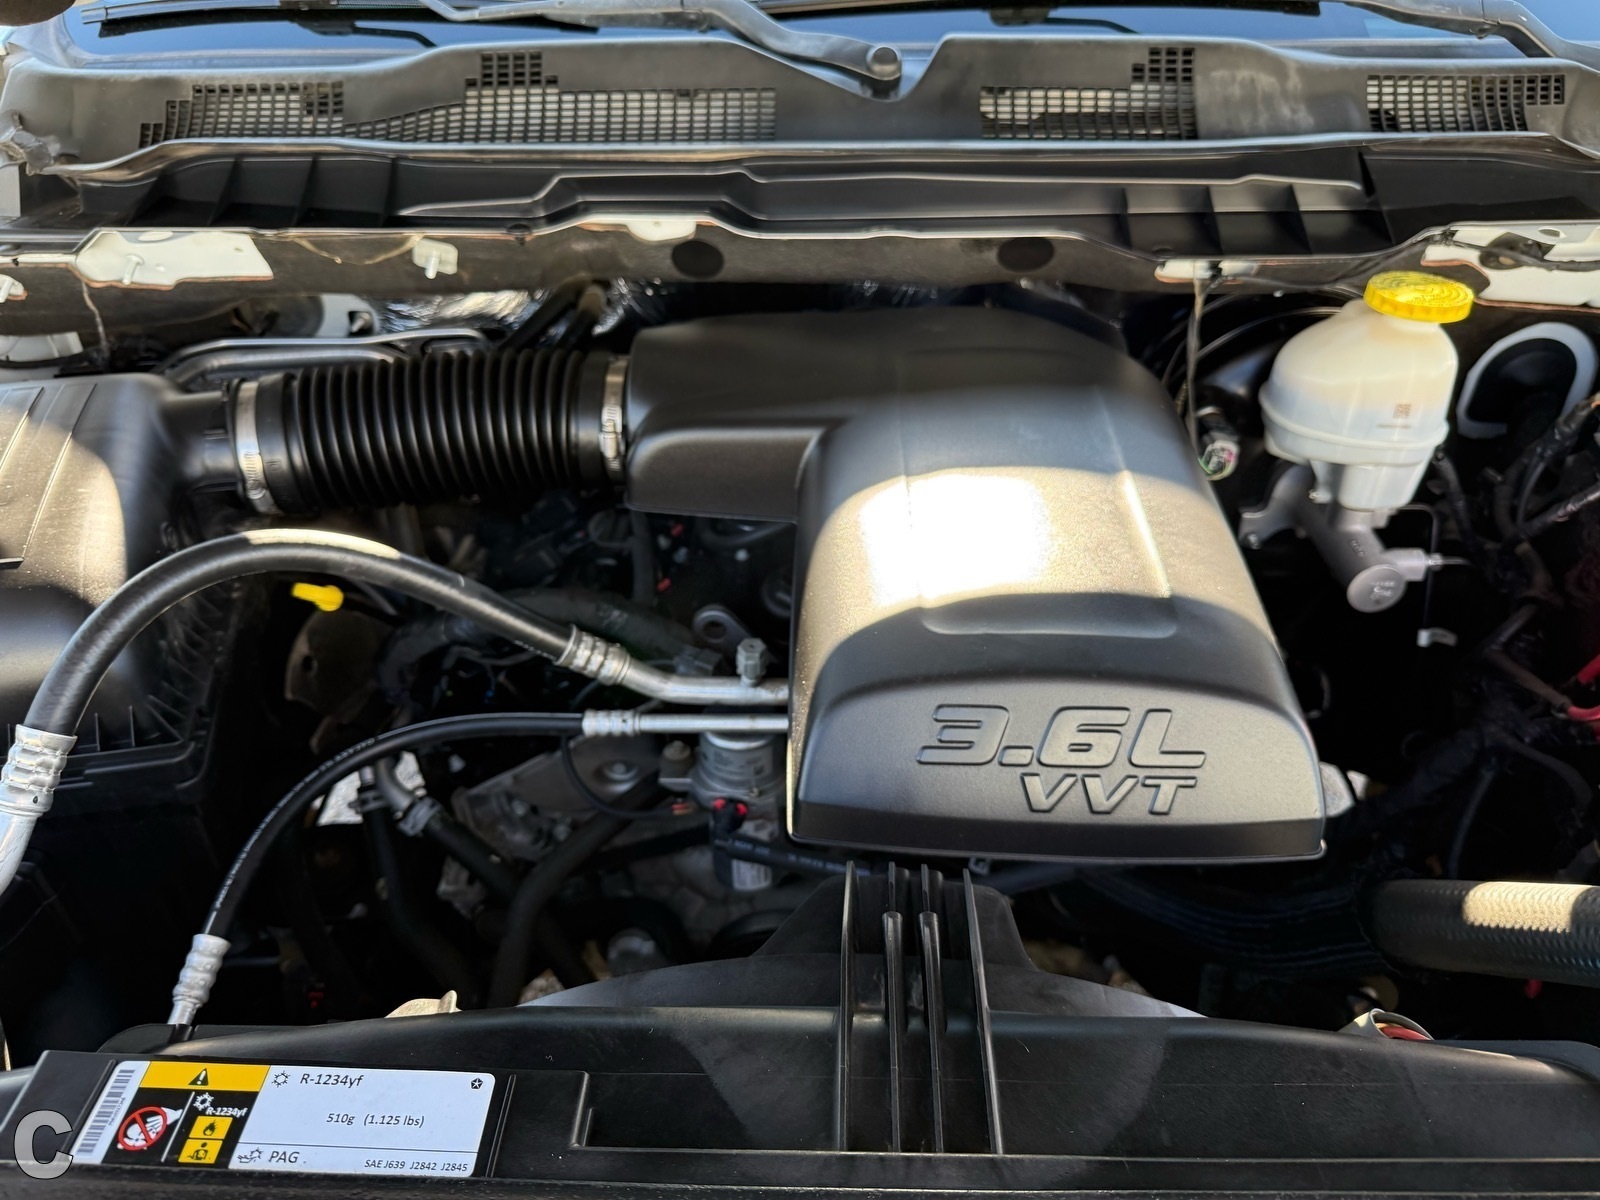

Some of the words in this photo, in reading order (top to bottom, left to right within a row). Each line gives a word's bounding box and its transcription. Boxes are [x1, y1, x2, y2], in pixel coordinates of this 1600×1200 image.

[916, 704, 1206, 769] 3.6L
[1020, 772, 1198, 815] VVT
[299, 1073, 364, 1088] R-1234yf
[205, 1106, 248, 1118] R-1234yf
[326, 1113, 355, 1126] 510g
[363, 1114, 400, 1126] (1.125
[403, 1115, 425, 1128] lbs)
[268, 1150, 300, 1164] PAG
[364, 1159, 383, 1168] SAE
[384, 1160, 406, 1169] J639
[410, 1161, 437, 1171] J2842
[441, 1162, 468, 1172] J2845
